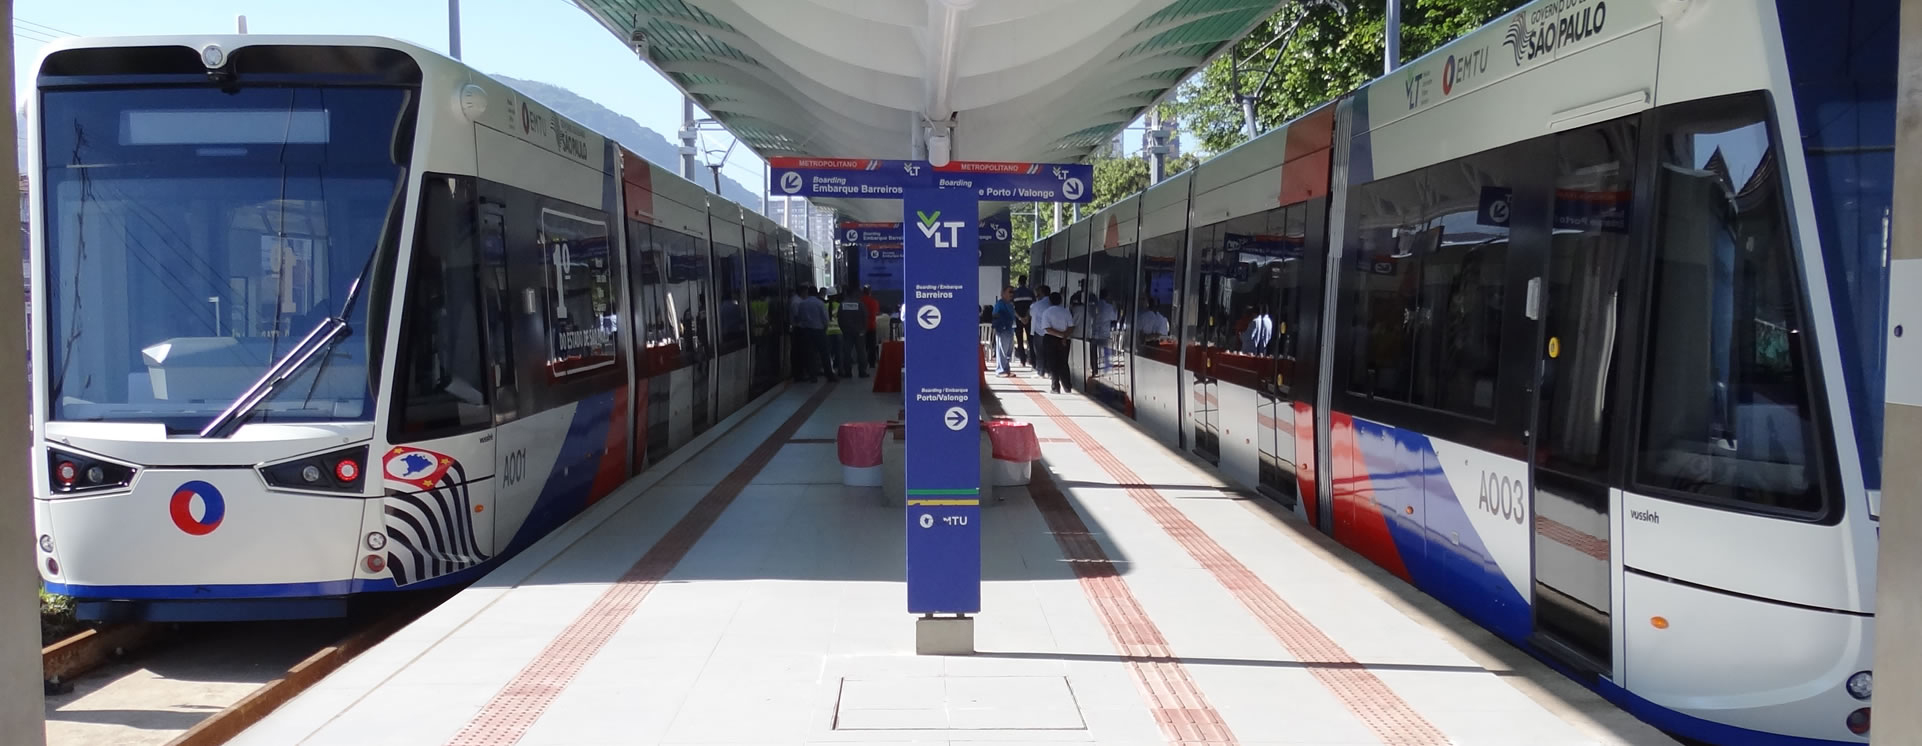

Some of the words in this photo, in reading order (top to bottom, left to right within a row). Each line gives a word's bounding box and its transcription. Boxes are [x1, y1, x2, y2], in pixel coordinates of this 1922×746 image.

[1528, 22, 1556, 60] SÃO
[1557, 1, 1606, 49] PAULO
[1456, 46, 1490, 84] EMTU
[799, 159, 858, 169] METROPOLITANO
[904, 162, 920, 176] VLT
[960, 163, 1019, 172] METROPOLITANO
[1053, 167, 1069, 180] VLT
[813, 176, 847, 185] Boarding
[939, 179, 973, 188] Boarding
[812, 184, 859, 195] Embarque
[861, 185, 903, 194] Barreiros
[986, 188, 1011, 197] Porto
[1018, 188, 1055, 199] Valongo
[916, 211, 966, 248] VLT
[916, 291, 953, 299] Barreiros
[916, 394, 969, 403] Porto/Valongo
[503, 447, 526, 489] A001
[1478, 470, 1525, 526] A003
